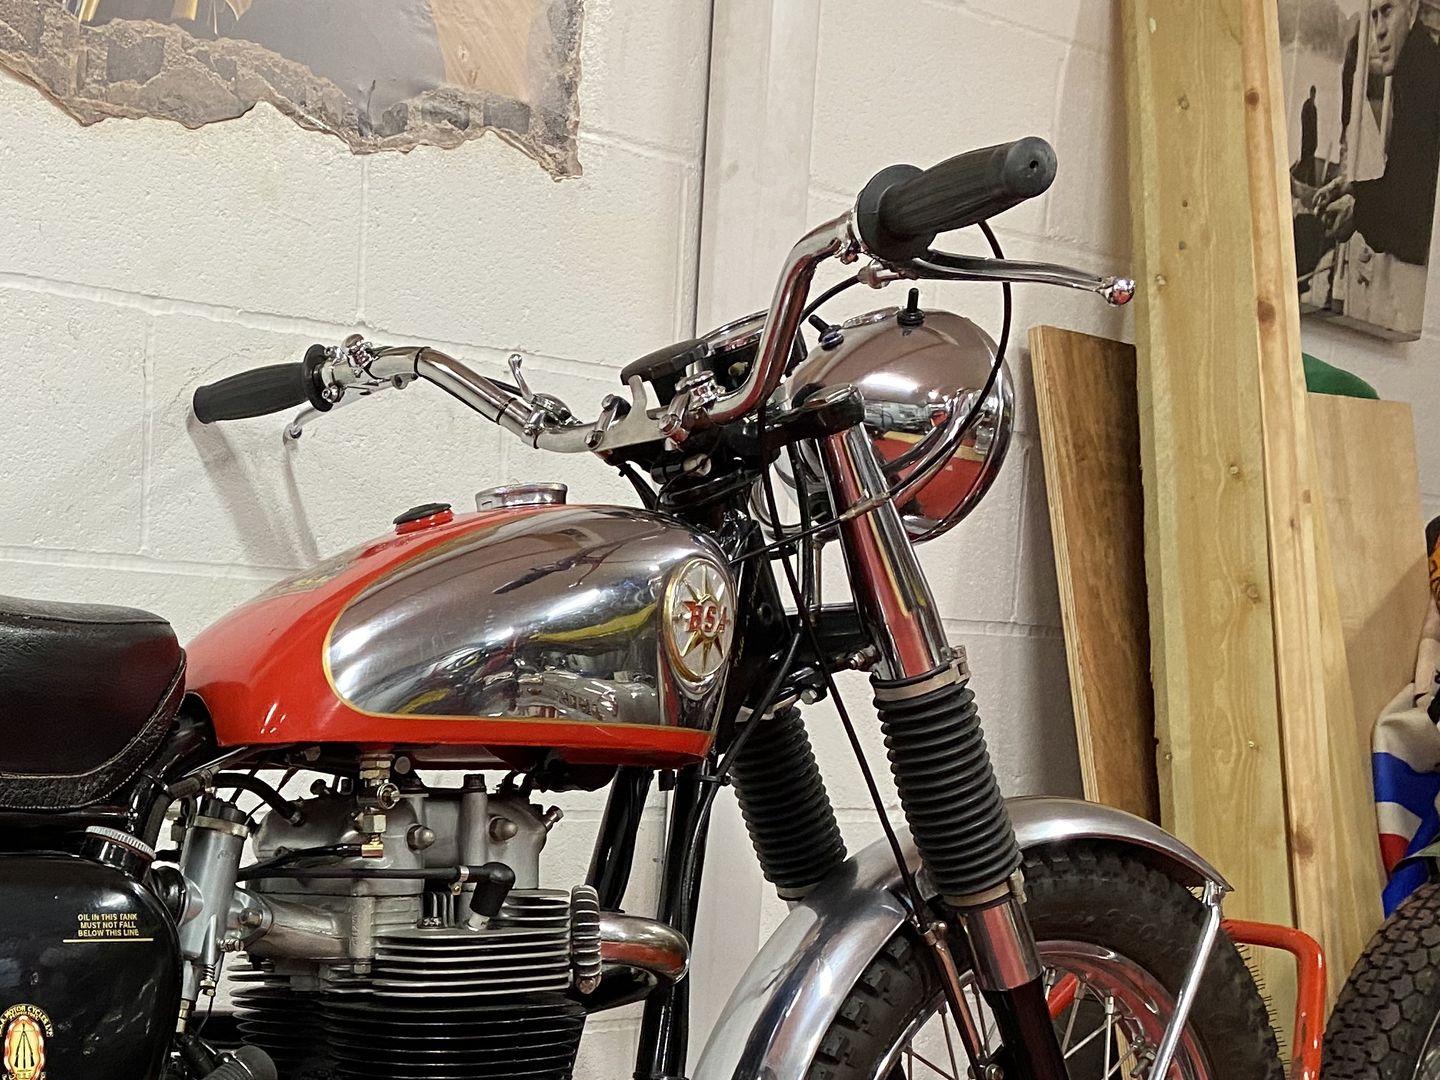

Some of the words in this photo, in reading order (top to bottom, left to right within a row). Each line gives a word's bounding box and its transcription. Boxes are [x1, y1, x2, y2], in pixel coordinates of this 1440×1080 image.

[683, 600, 729, 633] BSA
[77, 913, 90, 921] OIL
[80, 921, 100, 929] MUST
[102, 921, 117, 929] NOT
[78, 929, 104, 937] BELOW
[123, 928, 139, 936] LINE
[27, 1005, 49, 1025] CYCLES
